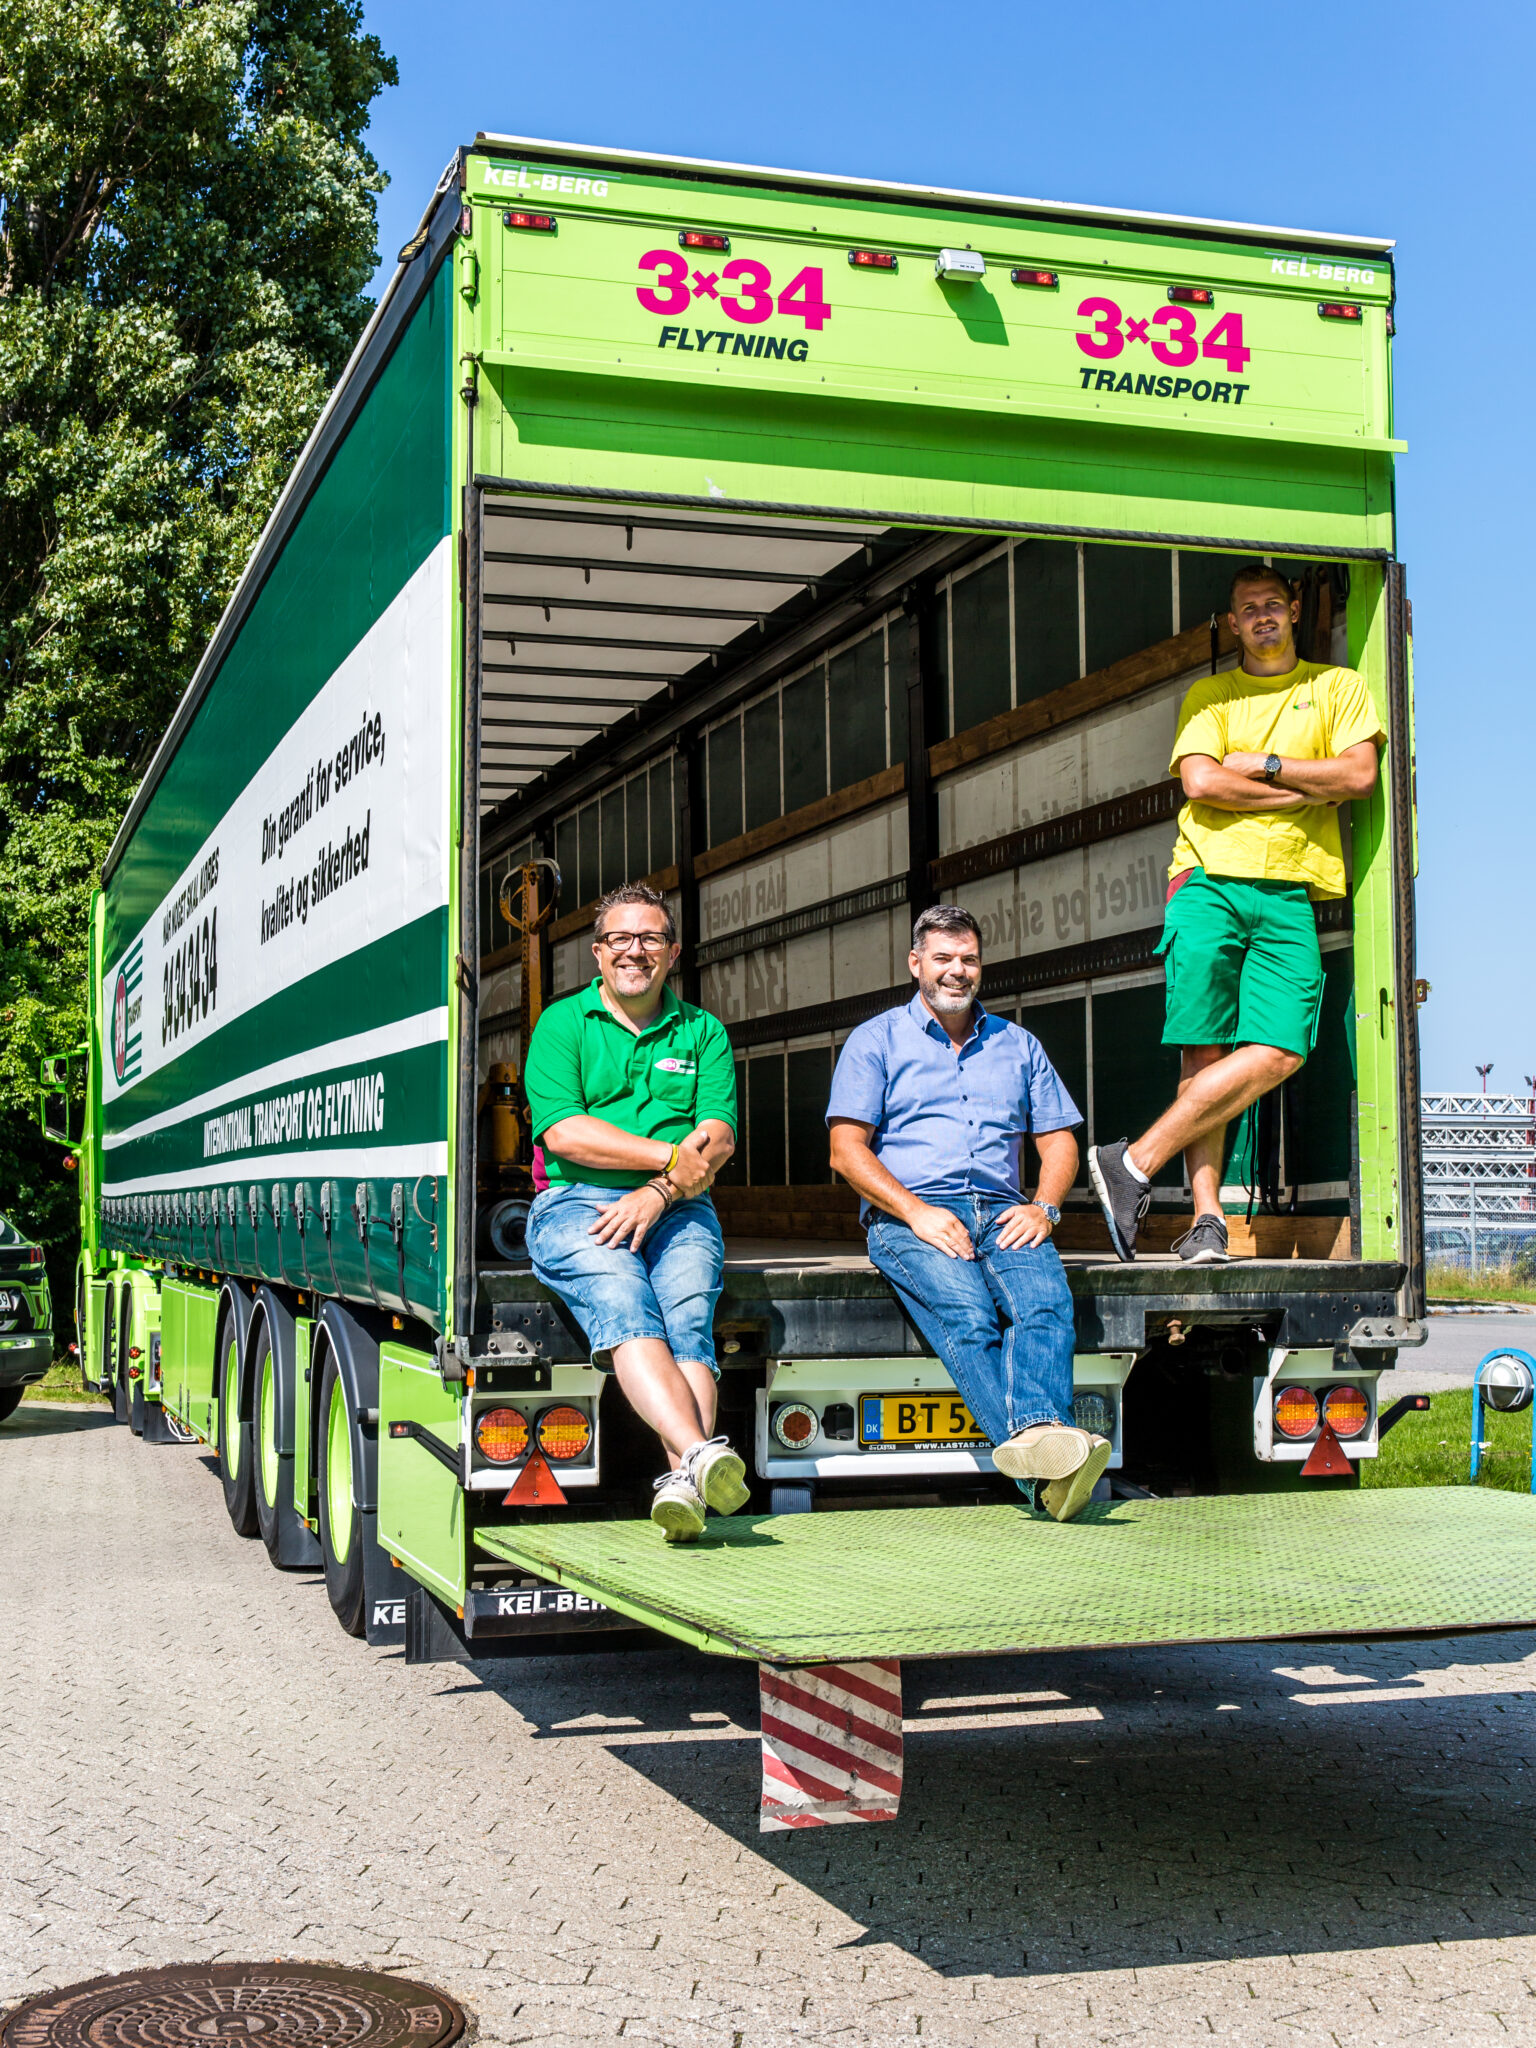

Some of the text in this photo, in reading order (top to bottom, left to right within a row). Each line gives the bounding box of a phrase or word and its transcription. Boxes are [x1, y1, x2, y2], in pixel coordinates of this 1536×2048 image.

[484, 166, 608, 197] KEL-BERG
[1271, 257, 1375, 285] KEL-BERG
[658, 326, 809, 362] FLYTNING
[1079, 368, 1250, 405] TRANSPORT
[262, 710, 385, 865] Din garanti for service,
[261, 808, 370, 945] kvalitet og sikkerhed
[204, 1072, 385, 1158] INTERNATIONAL TRANSPORT OG FLYTNING
[866, 1424, 878, 1433] DK
[898, 1403, 940, 1434] BT
[914, 1442, 991, 1450] WWW.LASTAS.DK
